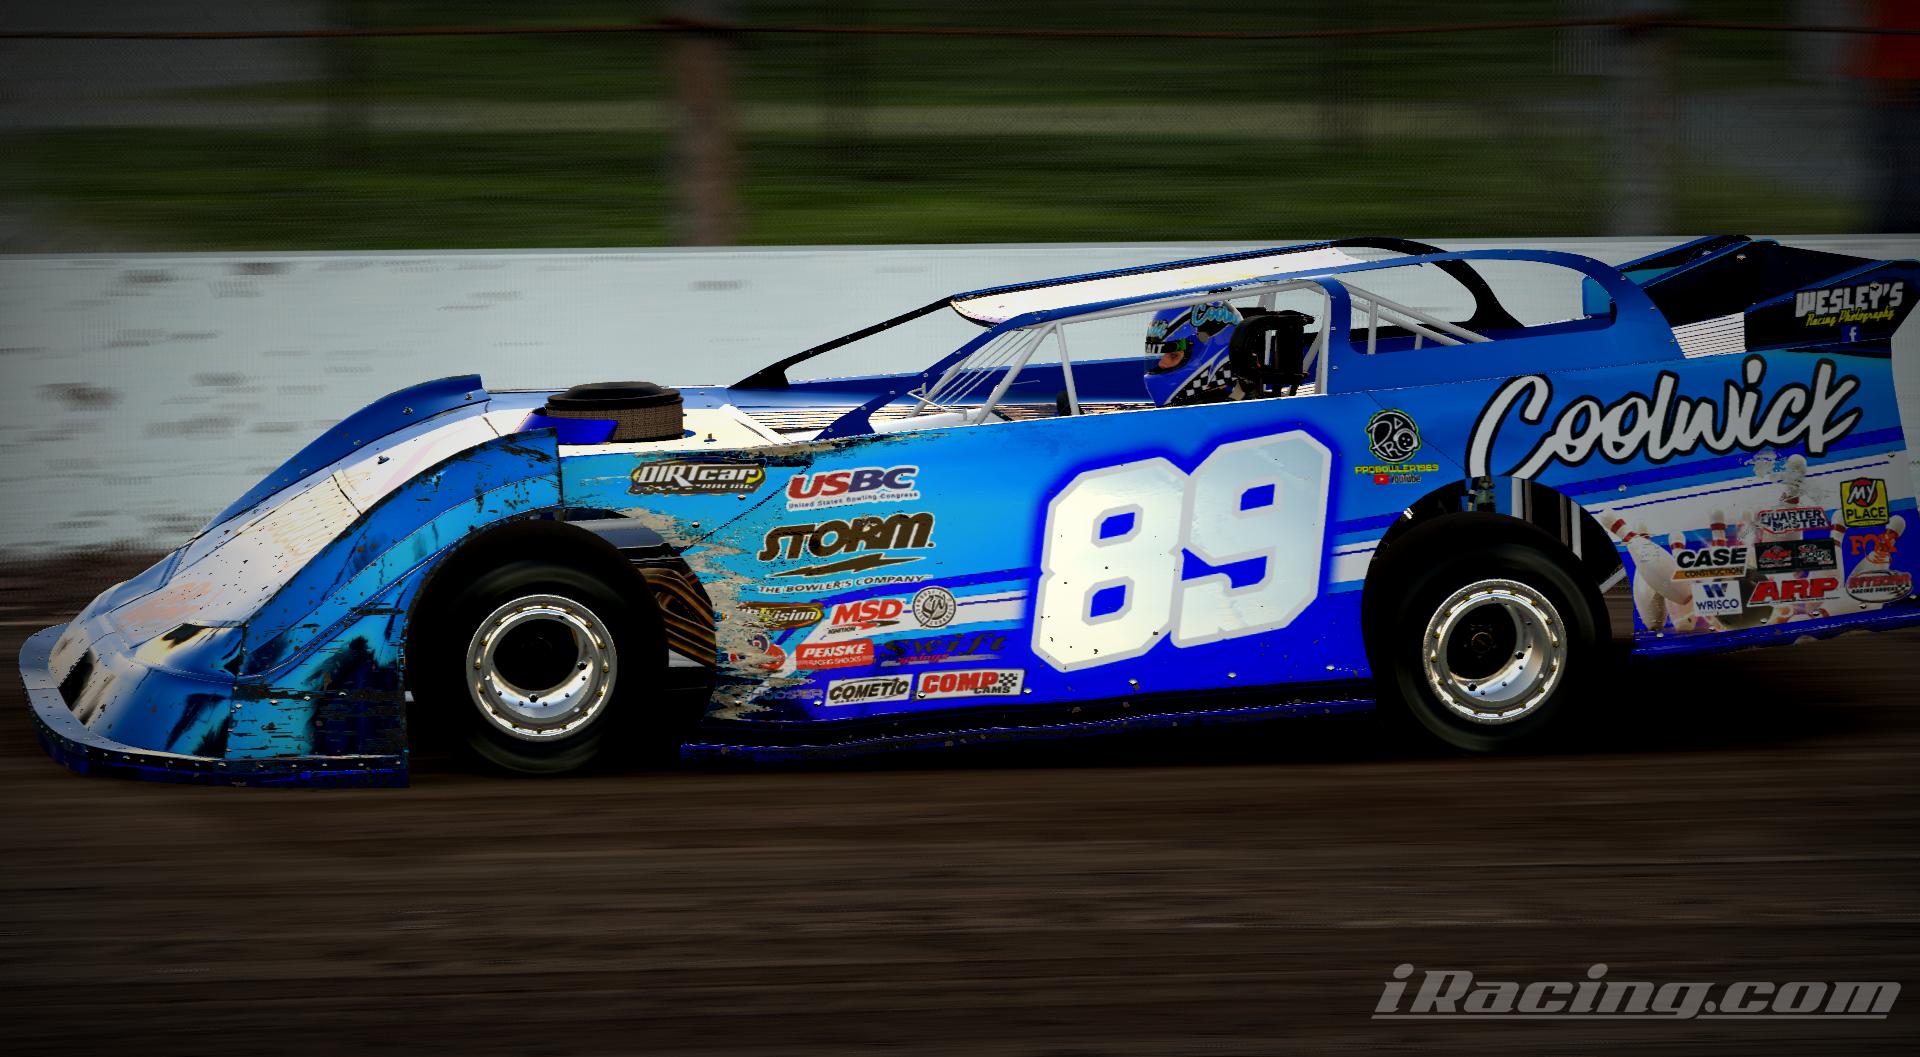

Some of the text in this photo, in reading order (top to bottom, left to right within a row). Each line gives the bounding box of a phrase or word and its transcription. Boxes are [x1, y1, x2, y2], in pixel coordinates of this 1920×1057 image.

[1795, 281, 1904, 318] WESLEY'S
[1466, 354, 1861, 480] Coolwick
[638, 464, 757, 487] DIRTcar
[788, 468, 917, 499] USBC
[788, 501, 814, 509] United
[846, 495, 877, 504] Bowling
[1847, 480, 1877, 504] MY
[1846, 507, 1886, 519] PLACE
[1031, 429, 1332, 673] 89
[1677, 548, 1747, 568] CASE
[1684, 567, 1743, 578] CONSTRUCTION
[760, 575, 924, 594] THE BOWLER'S COMPANY
[1750, 577, 1839, 602] ARP
[831, 600, 901, 626] MSD
[1696, 599, 1739, 611] WRISCO
[827, 626, 856, 634] IGNITION
[802, 643, 866, 659] PENSKE
[829, 678, 909, 701] COMETIC
[923, 672, 999, 694] COMP
[974, 686, 1011, 694] CAMS
